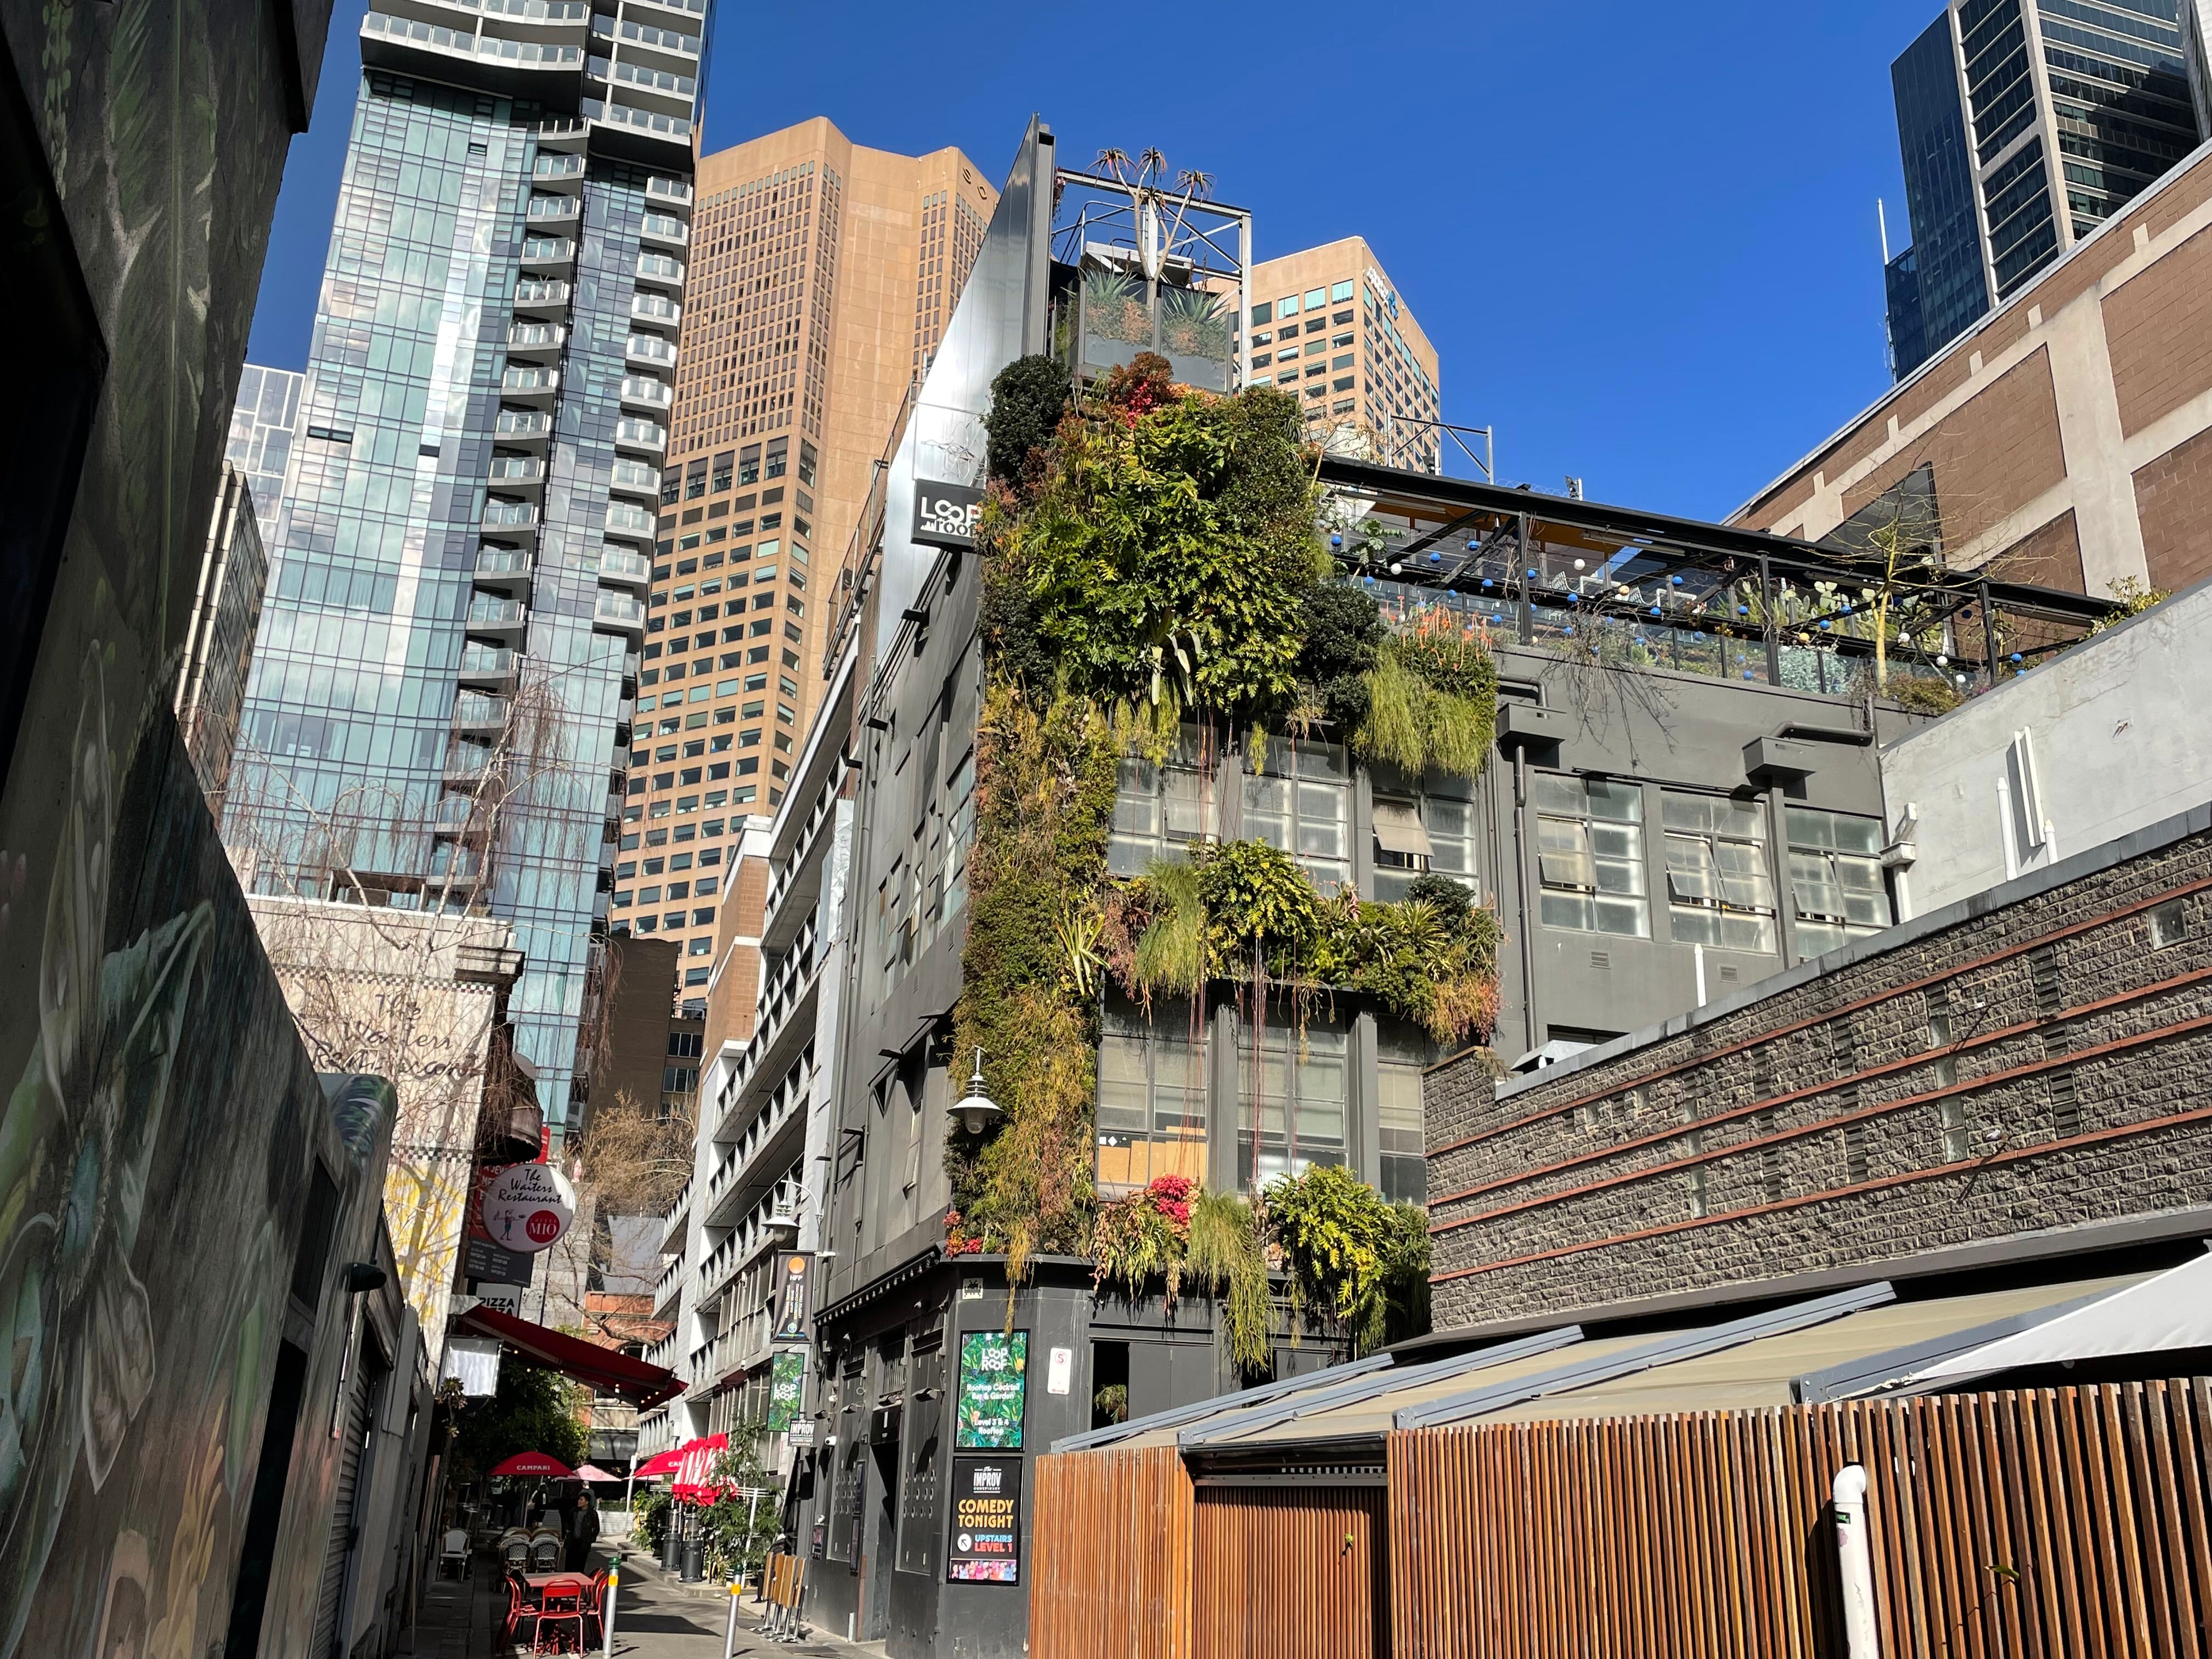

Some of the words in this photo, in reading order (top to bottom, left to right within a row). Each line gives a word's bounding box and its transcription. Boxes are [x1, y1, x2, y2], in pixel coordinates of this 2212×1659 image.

[921, 496, 984, 524] LOOP
[524, 1169, 541, 1181] The
[511, 1178, 552, 1193] Waiters
[498, 1189, 562, 1203] Restaurant
[529, 1223, 557, 1235] MIO
[479, 1297, 515, 1308] PIZZA
[981, 1347, 1008, 1360] LOOP
[981, 1358, 1008, 1371] ROOF
[774, 1383, 797, 1392] LOOP
[967, 1383, 992, 1392] Rooftop
[993, 1383, 1020, 1391] Cocktail
[773, 1391, 797, 1401] ROOF
[990, 1392, 1014, 1400] Garden
[974, 1418, 992, 1426] Level
[790, 1424, 815, 1435] IMPROV
[978, 1426, 1004, 1436] Rooftop
[973, 1472, 1002, 1487] IMPROV
[958, 1499, 1014, 1514] COMEDY
[958, 1514, 1014, 1528] TONIGHT
[974, 1534, 1013, 1543] UPSTAIRS
[974, 1542, 1006, 1552] LEVEL
[1007, 1543, 1012, 1553] 1
